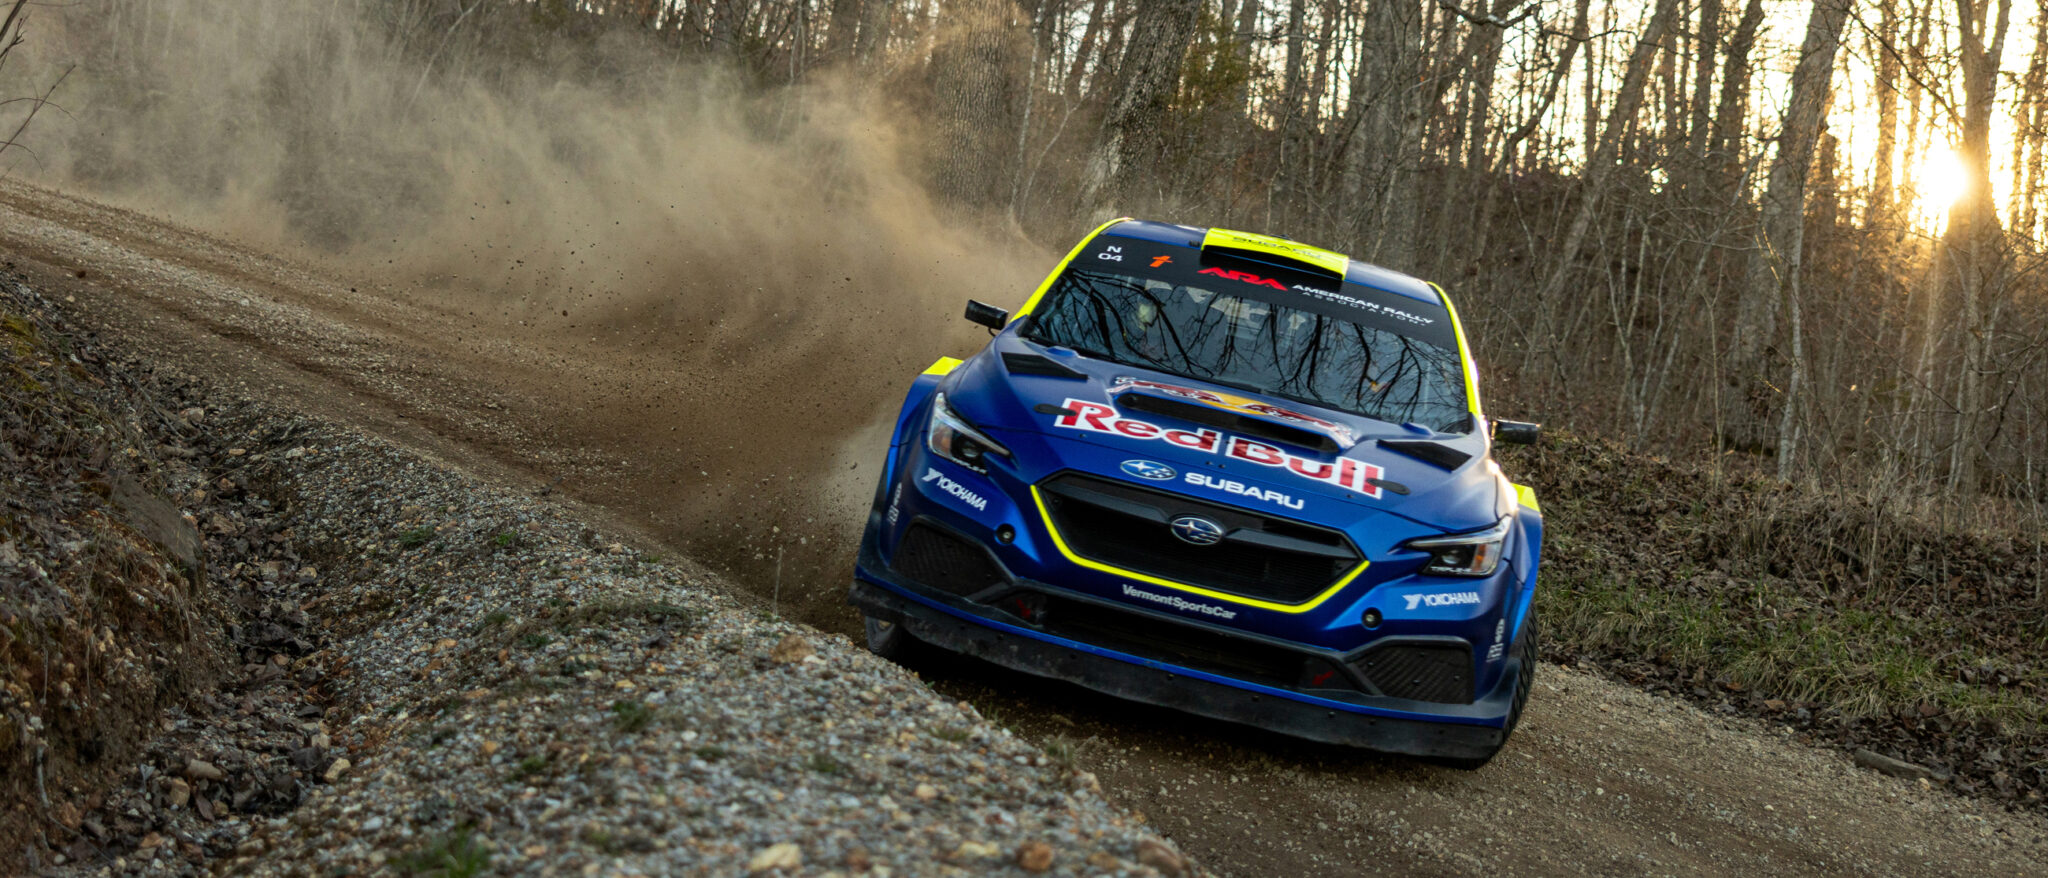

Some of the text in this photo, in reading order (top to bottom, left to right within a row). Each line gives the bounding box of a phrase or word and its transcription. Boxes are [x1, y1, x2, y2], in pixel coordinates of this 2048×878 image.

[1098, 252, 1123, 262] 04
[1107, 245, 1122, 253] N
[1197, 266, 1288, 291] ARA
[1292, 284, 1435, 324] AMERICAN RALLY
[1056, 399, 1383, 498] Red Bull
[935, 475, 988, 512] YOKOHAMA
[1184, 472, 1304, 511] SUBARU
[1122, 583, 1238, 619] VermontSportsCar
[1421, 591, 1481, 607] YOKOHAMA
